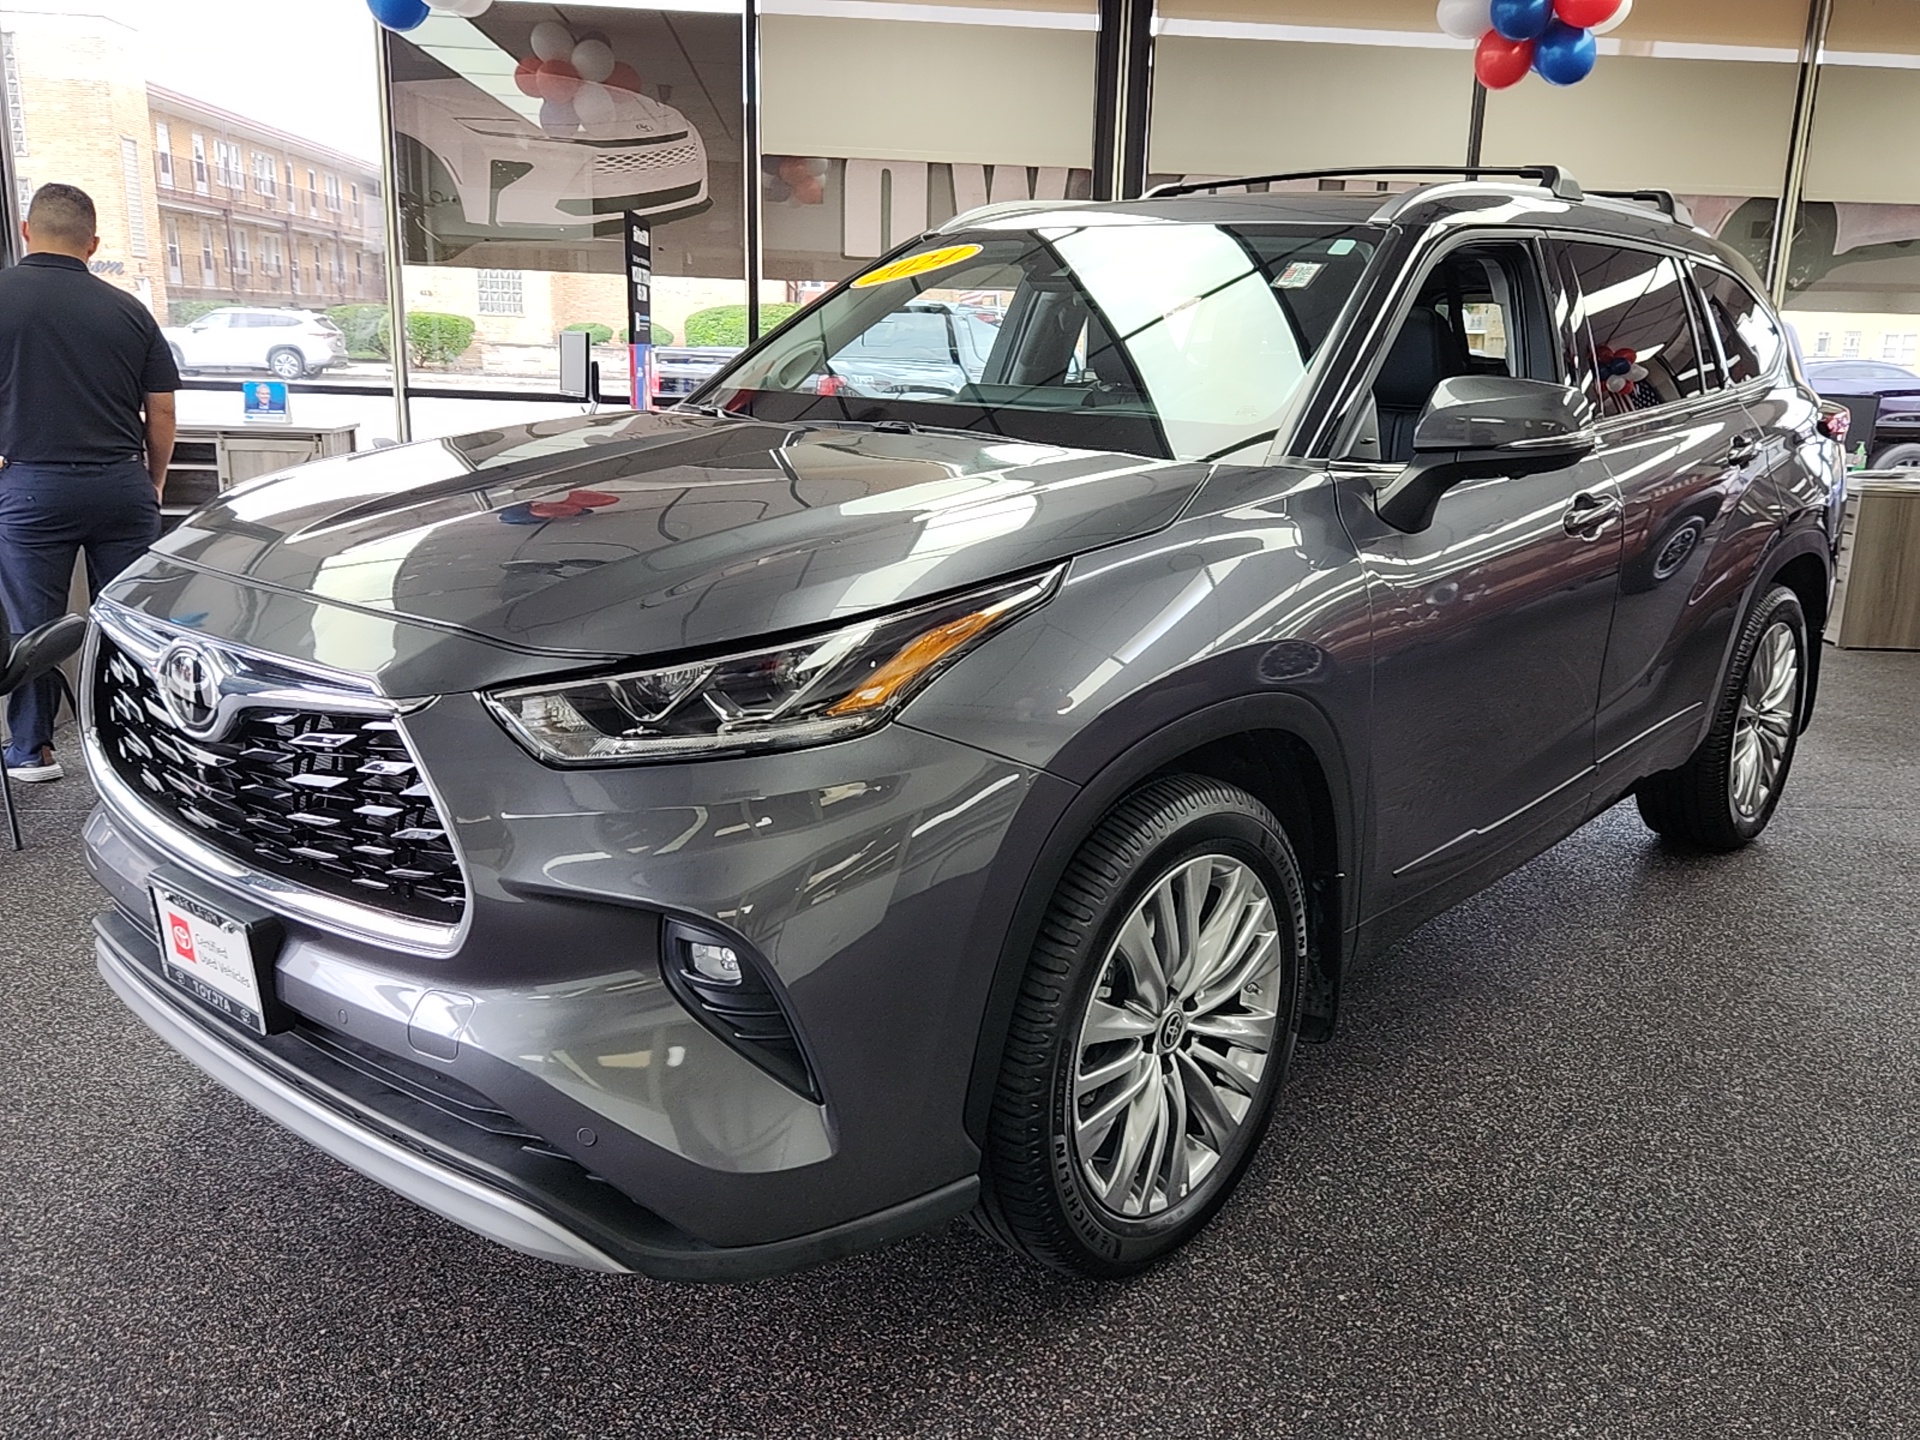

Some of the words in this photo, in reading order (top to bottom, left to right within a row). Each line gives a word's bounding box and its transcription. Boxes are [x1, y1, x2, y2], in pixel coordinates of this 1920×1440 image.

[1276, 854, 1306, 950] MICHELIN
[194, 931, 229, 960] Certified
[198, 949, 218, 970] Used
[219, 960, 251, 989] Vehicles
[192, 980, 232, 1013] TOYOTA
[1055, 1142, 1101, 1241] MICHELIN
